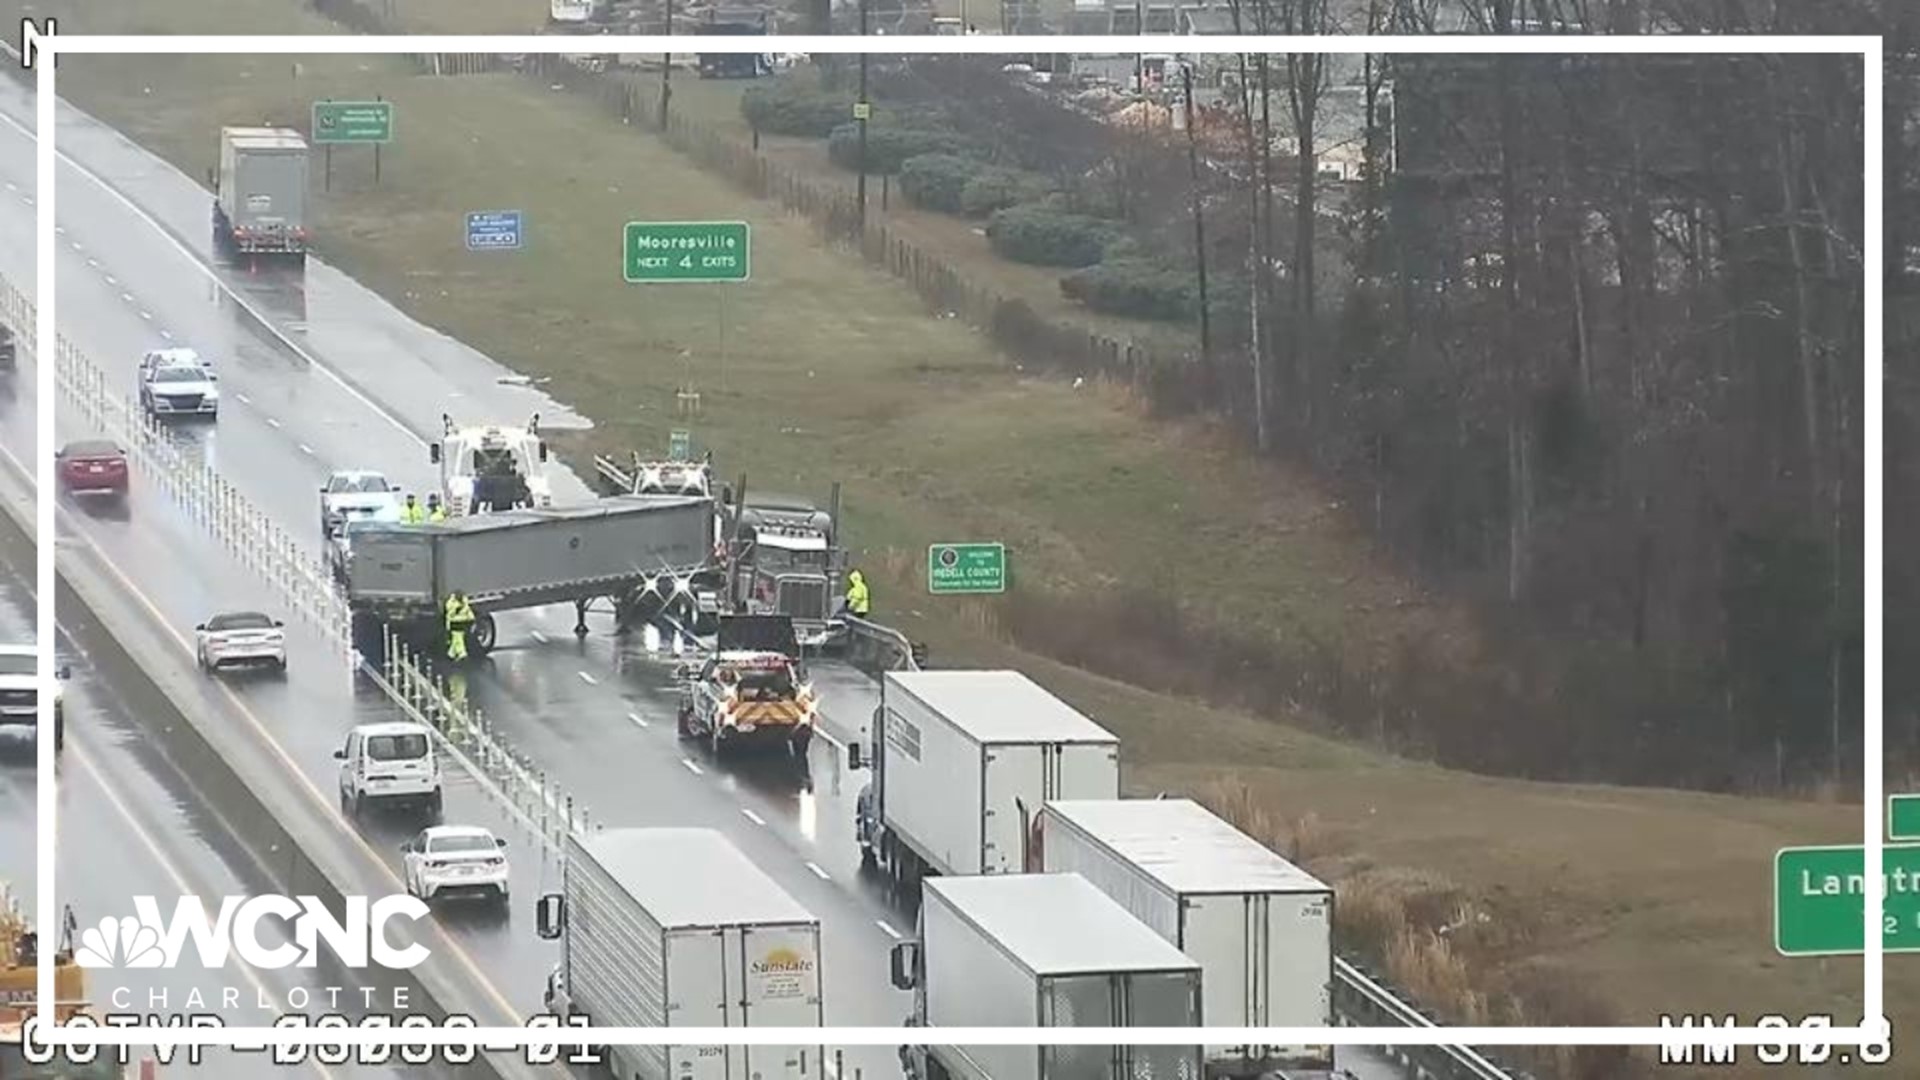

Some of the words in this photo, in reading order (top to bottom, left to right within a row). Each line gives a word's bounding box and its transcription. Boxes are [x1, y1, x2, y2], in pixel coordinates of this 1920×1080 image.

[638, 235, 735, 249] Mooresville
[637, 257, 669, 268] NEXT
[679, 255, 693, 268] 4
[702, 256, 737, 268] EXITS
[967, 567, 1000, 577] COUNTY
[750, 960, 814, 973] Sunstate
